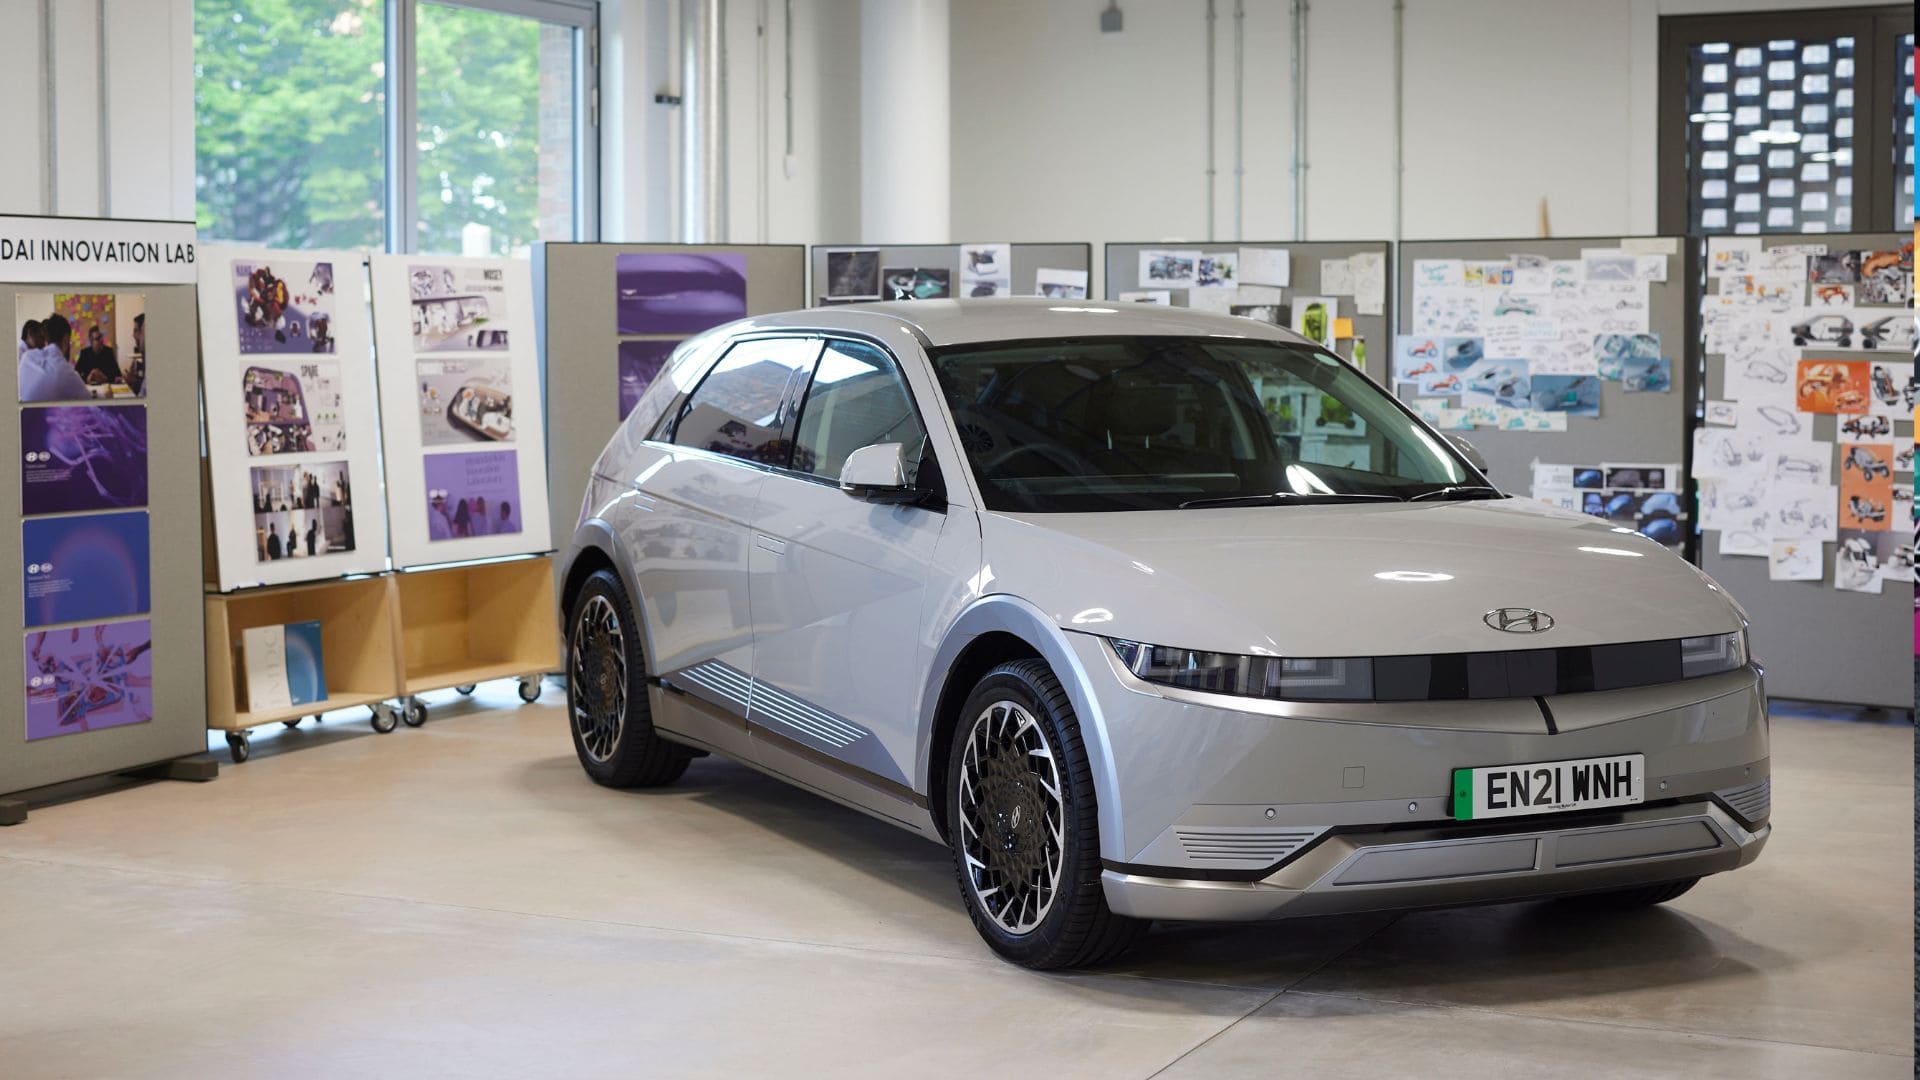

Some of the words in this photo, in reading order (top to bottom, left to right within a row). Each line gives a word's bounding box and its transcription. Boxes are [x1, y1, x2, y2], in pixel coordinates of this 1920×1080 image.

[41, 240, 159, 263] INNOVATION
[166, 244, 195, 264] LAB
[1488, 767, 1561, 809] EN21
[1572, 761, 1632, 801] WNH
